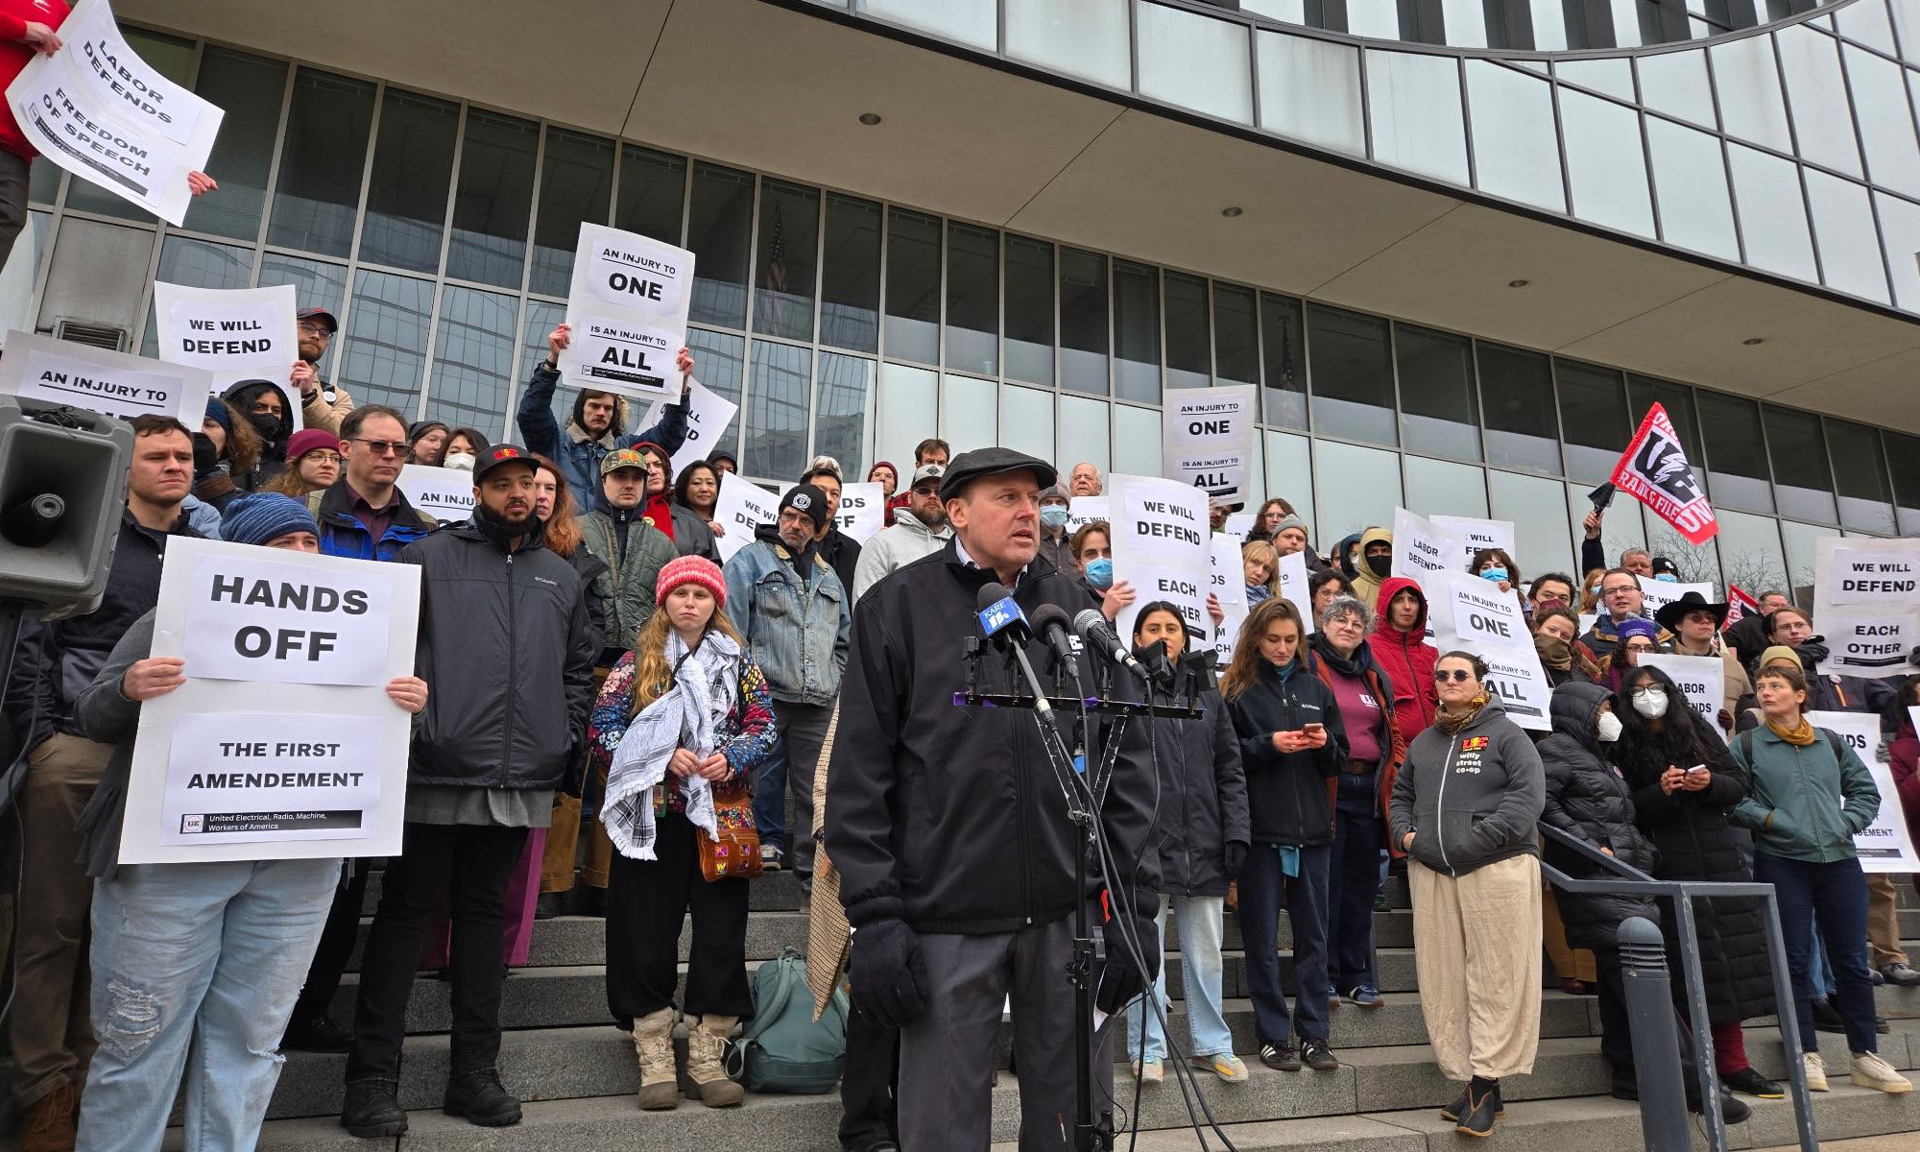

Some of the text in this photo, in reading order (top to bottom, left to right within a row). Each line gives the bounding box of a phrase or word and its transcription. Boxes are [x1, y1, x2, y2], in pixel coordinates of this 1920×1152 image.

[99, 40, 164, 104] LABOR
[84, 41, 172, 124] DEFENDS
[55, 87, 147, 158] FREEDOM
[43, 94, 61, 119] OF
[64, 123, 150, 176] SPEECH
[603, 248, 676, 275] AN INJURY TO
[608, 272, 663, 302] ONE
[189, 319, 261, 331] WE WILL
[590, 325, 667, 346] IS AN INJURY TO
[183, 338, 271, 354] DEFEND
[601, 346, 652, 371] ALL
[40, 370, 167, 401] AN INJURY TO
[1189, 420, 1230, 436] ONE
[1193, 473, 1229, 488] ALL
[420, 492, 475, 506] AN INJU
[745, 500, 761, 514] WE
[763, 510, 776, 522] WI
[1143, 500, 1195, 521] WE WILL
[1655, 498, 1680, 521] FILE
[1137, 520, 1200, 546] DEFEND
[1470, 534, 1494, 542] WILL
[1413, 538, 1439, 557] LABOR
[1852, 563, 1911, 572] WE WILL
[210, 574, 368, 615] HANDS
[1158, 578, 1196, 597] EACH
[1843, 580, 1915, 592] DEFEND
[984, 602, 1006, 618] KARE
[1458, 591, 1512, 613] AN INJURY TO
[1178, 605, 1201, 622] HER
[1469, 613, 1511, 638] ONE
[1855, 625, 1899, 636] EACH
[234, 625, 338, 661] OFF
[1848, 643, 1901, 654] OTHER
[1492, 663, 1518, 674] INJURY
[1485, 680, 1527, 701] ALL
[1678, 683, 1705, 693] ABOR
[219, 743, 340, 757] THE FIRST
[187, 772, 364, 789] AMENDEMENT
[209, 812, 327, 822] United Electrical, Radio, Machine,
